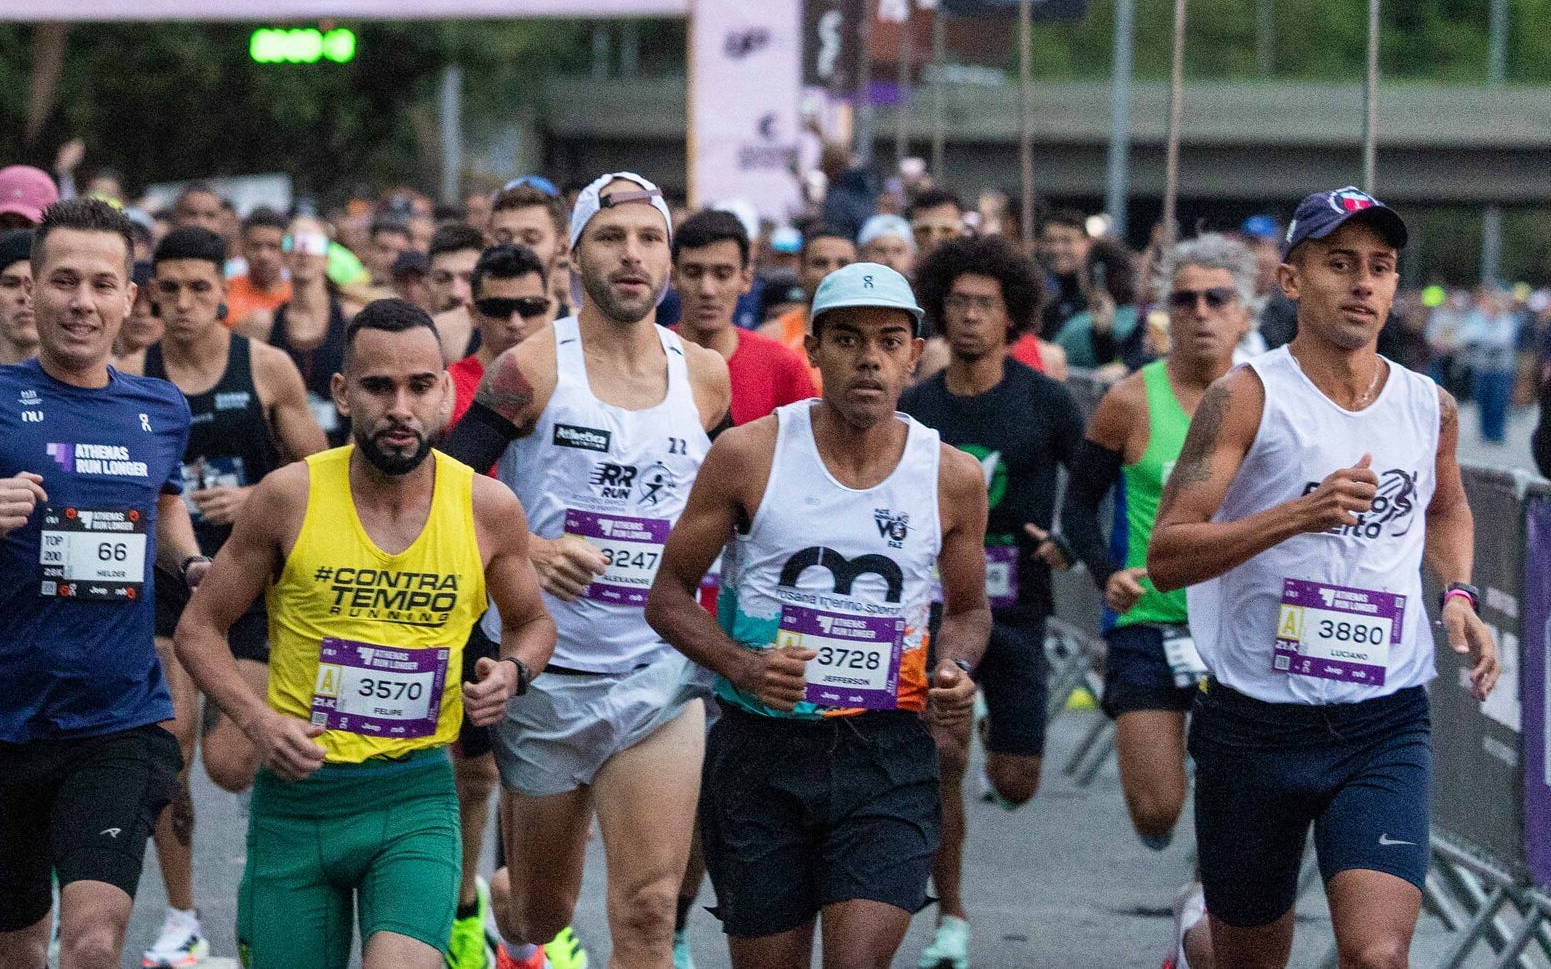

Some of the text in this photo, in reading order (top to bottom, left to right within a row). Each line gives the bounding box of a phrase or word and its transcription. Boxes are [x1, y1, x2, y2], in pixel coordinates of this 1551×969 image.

[75, 443, 130, 461] ATHENAS
[75, 458, 149, 477] RUN LONGER
[600, 486, 631, 500] RUN
[93, 511, 126, 522] ATHENAS
[45, 535, 63, 547] TOP
[44, 550, 62, 561] 200
[97, 541, 128, 562] 66
[601, 548, 658, 570] 3247
[96, 570, 127, 578] HELDER
[313, 565, 458, 592] #CONTRA
[330, 586, 458, 613] TEMPO
[776, 587, 817, 605] rosana
[819, 595, 862, 611] merino
[329, 607, 450, 622] RUNNING
[1283, 610, 1296, 634] A
[1318, 619, 1384, 646] 3880
[374, 649, 409, 661] ATHENAS
[817, 646, 881, 670] 3728
[1330, 648, 1369, 661] LUCIANO
[320, 669, 336, 693] A
[358, 678, 423, 701] 3570
[823, 675, 871, 686] JEFFERSON
[374, 707, 404, 717] FELIPE
